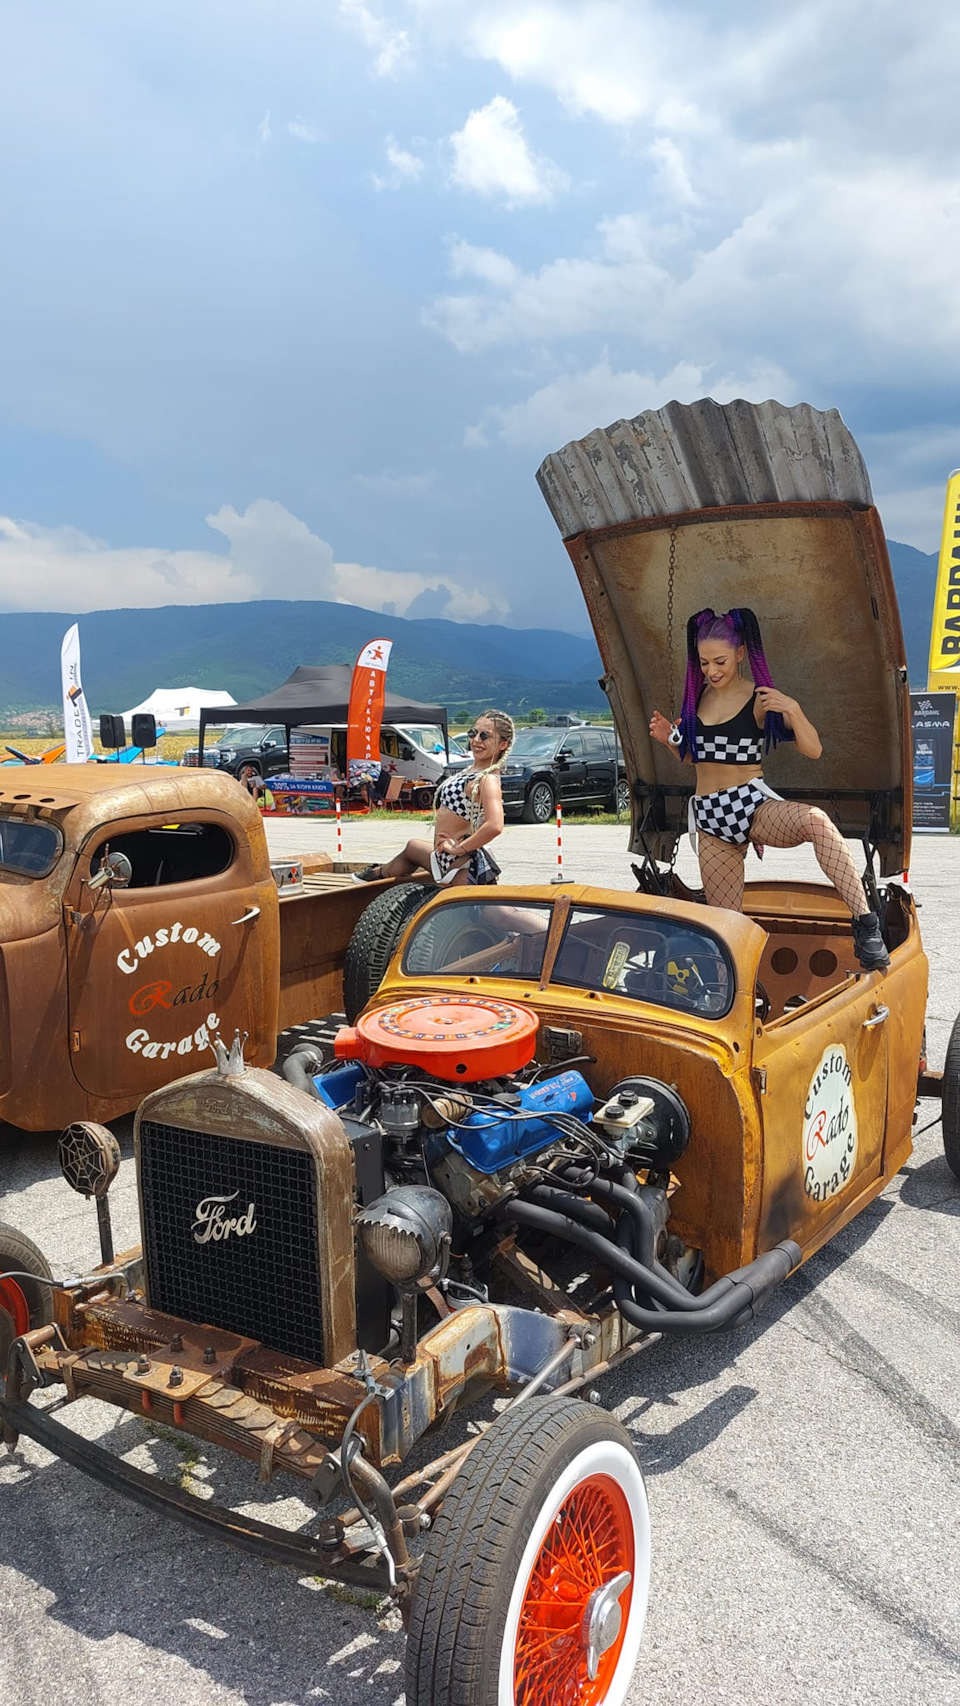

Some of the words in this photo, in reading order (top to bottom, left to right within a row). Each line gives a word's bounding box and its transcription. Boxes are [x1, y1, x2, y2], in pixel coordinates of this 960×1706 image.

[941, 503, 960, 655] BARD
[74, 709, 85, 757] TRADE
[365, 670, 376, 759] АВТОКЛЮЧАР
[271, 782, 290, 791] -30%
[117, 922, 221, 974] Custom
[129, 973, 220, 1015] Rado
[125, 1012, 220, 1060] Garage
[205, 1097, 230, 1115] Ford
[804, 1052, 852, 1120] Custom
[806, 1095, 850, 1161] Rado
[804, 1133, 855, 1203] Garage
[190, 1189, 257, 1244] Ford
